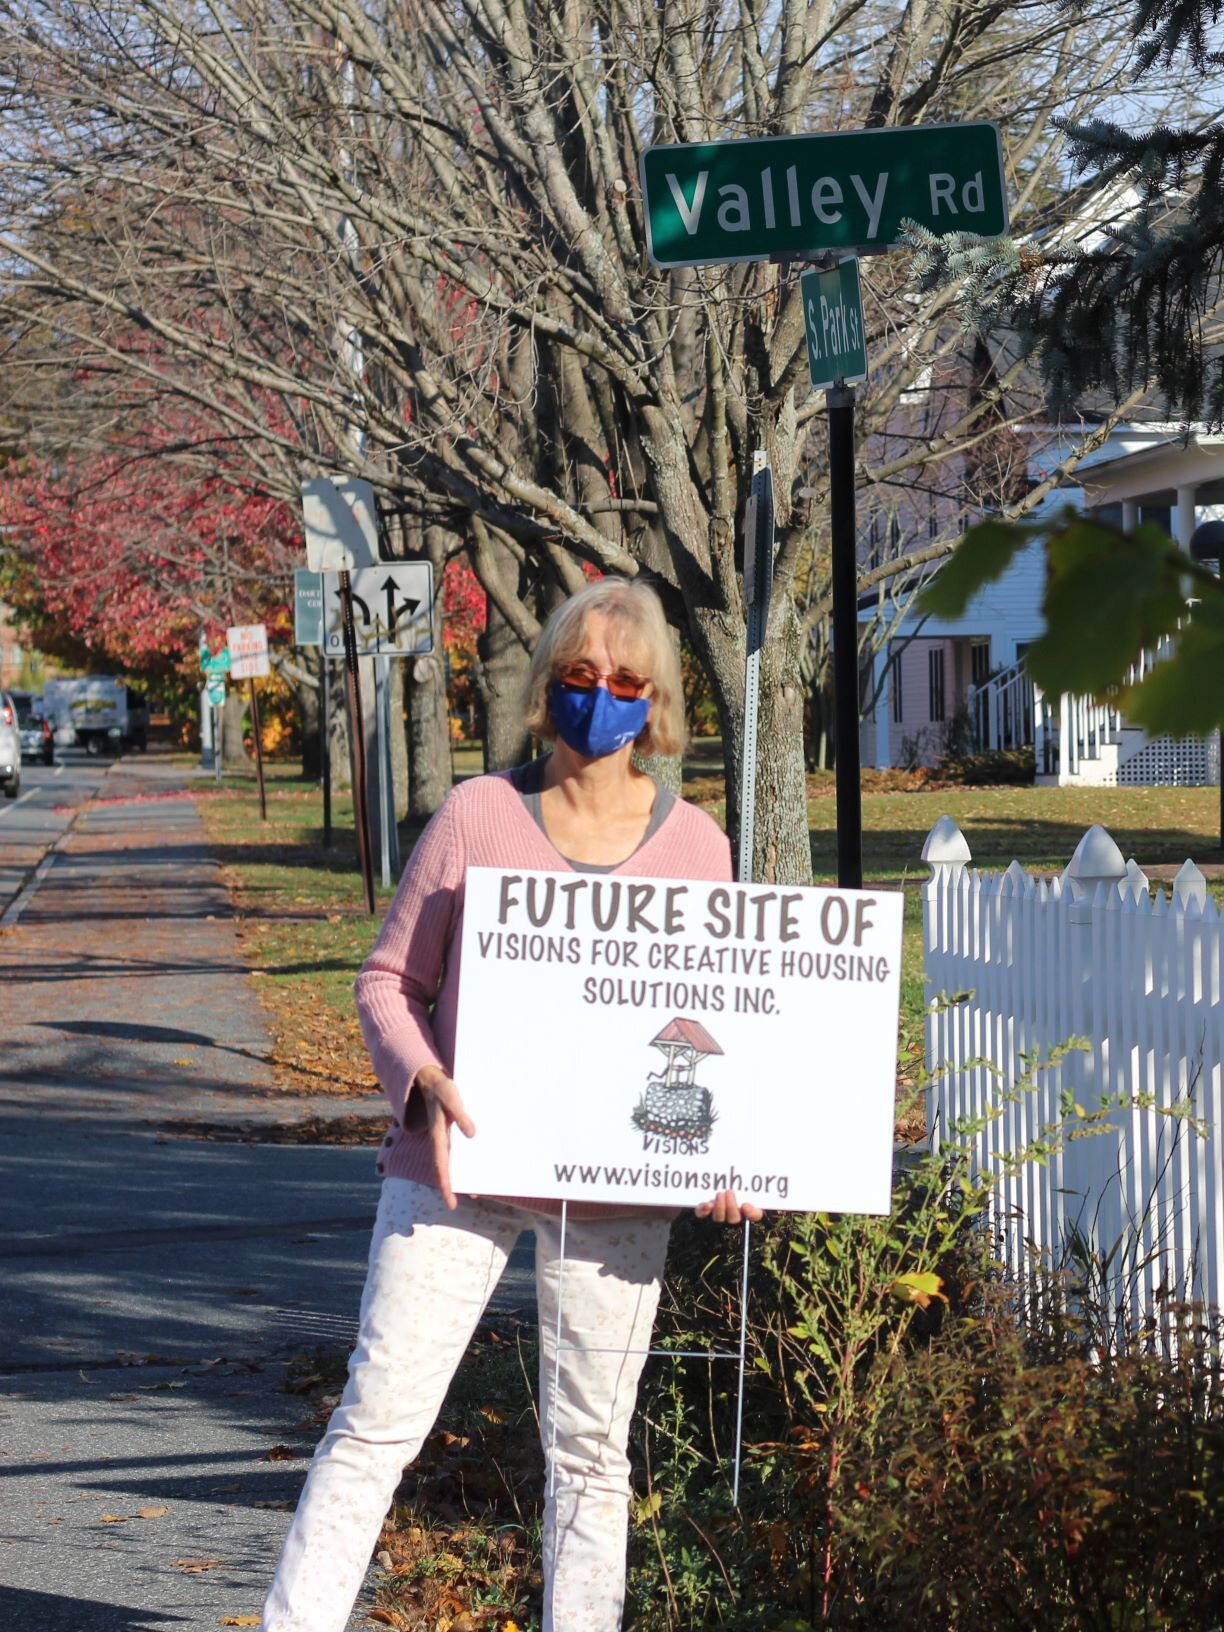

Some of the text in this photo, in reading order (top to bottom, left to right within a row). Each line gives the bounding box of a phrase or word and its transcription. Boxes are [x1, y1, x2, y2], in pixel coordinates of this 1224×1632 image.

[665, 165, 985, 239] Valley Rd
[808, 298, 822, 361] S.
[820, 290, 850, 358] Park
[497, 874, 878, 948] FUTURE SITE OF
[477, 931, 891, 983] VISIONS FOR CREATIVE HOUSING
[582, 976, 780, 1015] SOLUTIONS INC.
[641, 1134, 710, 1156] VISIONS
[553, 1161, 789, 1199] www.visionsnh.org
